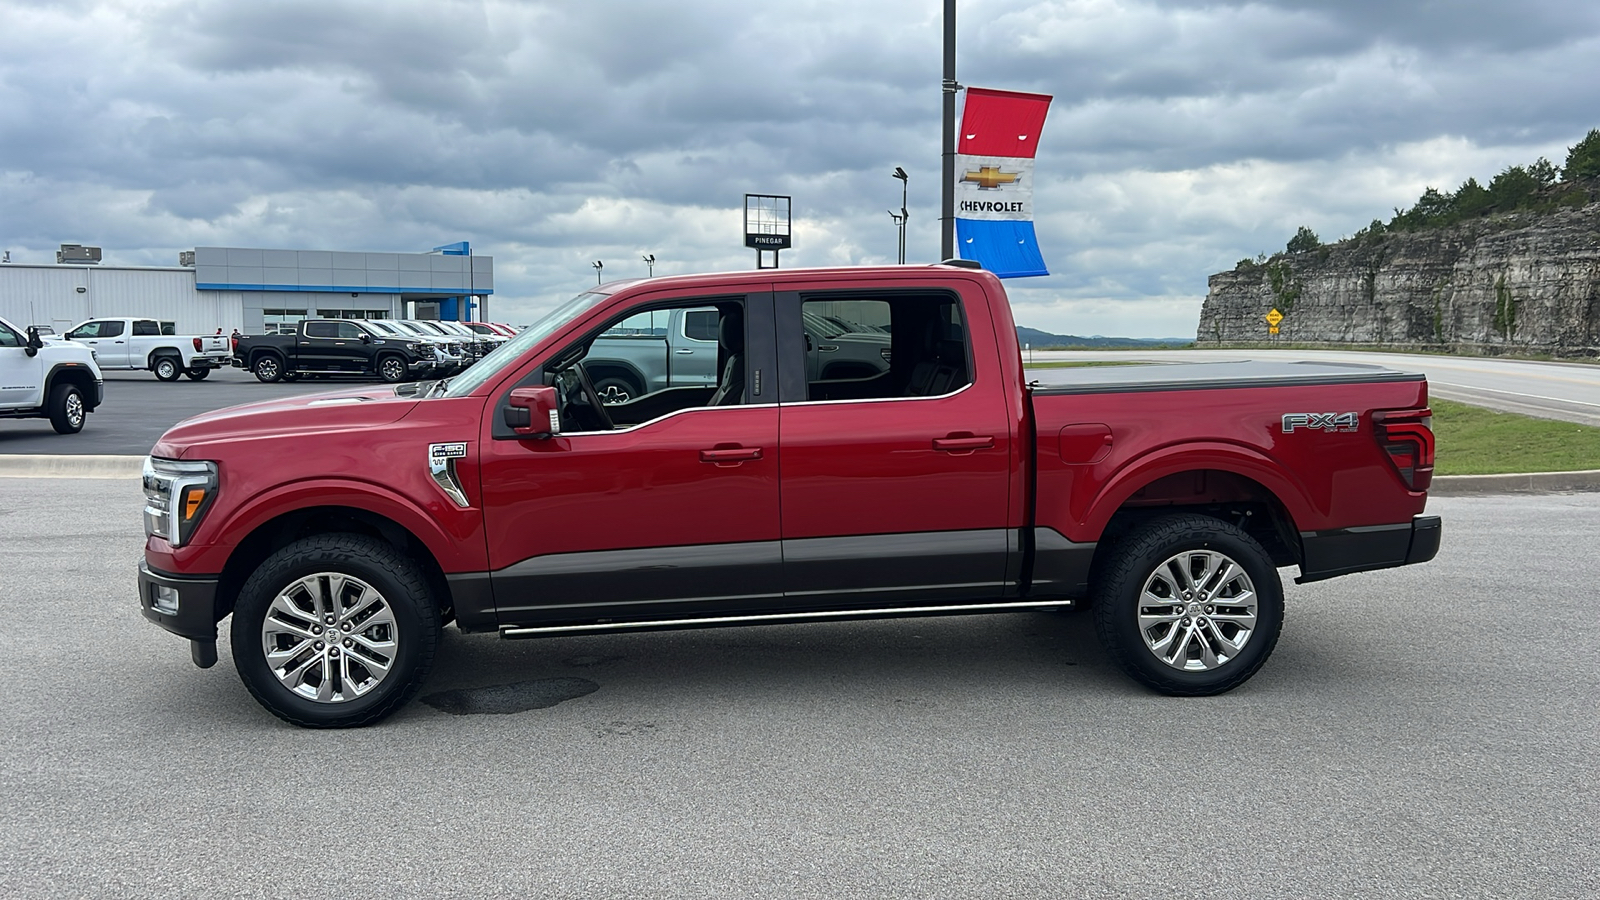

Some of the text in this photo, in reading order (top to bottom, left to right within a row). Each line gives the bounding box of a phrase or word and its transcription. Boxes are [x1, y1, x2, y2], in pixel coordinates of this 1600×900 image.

[960, 200, 1024, 212] CHEVROLET
[755, 237, 783, 245] PINEGAR
[1281, 412, 1359, 434] FX4
[433, 444, 464, 452] F-150
